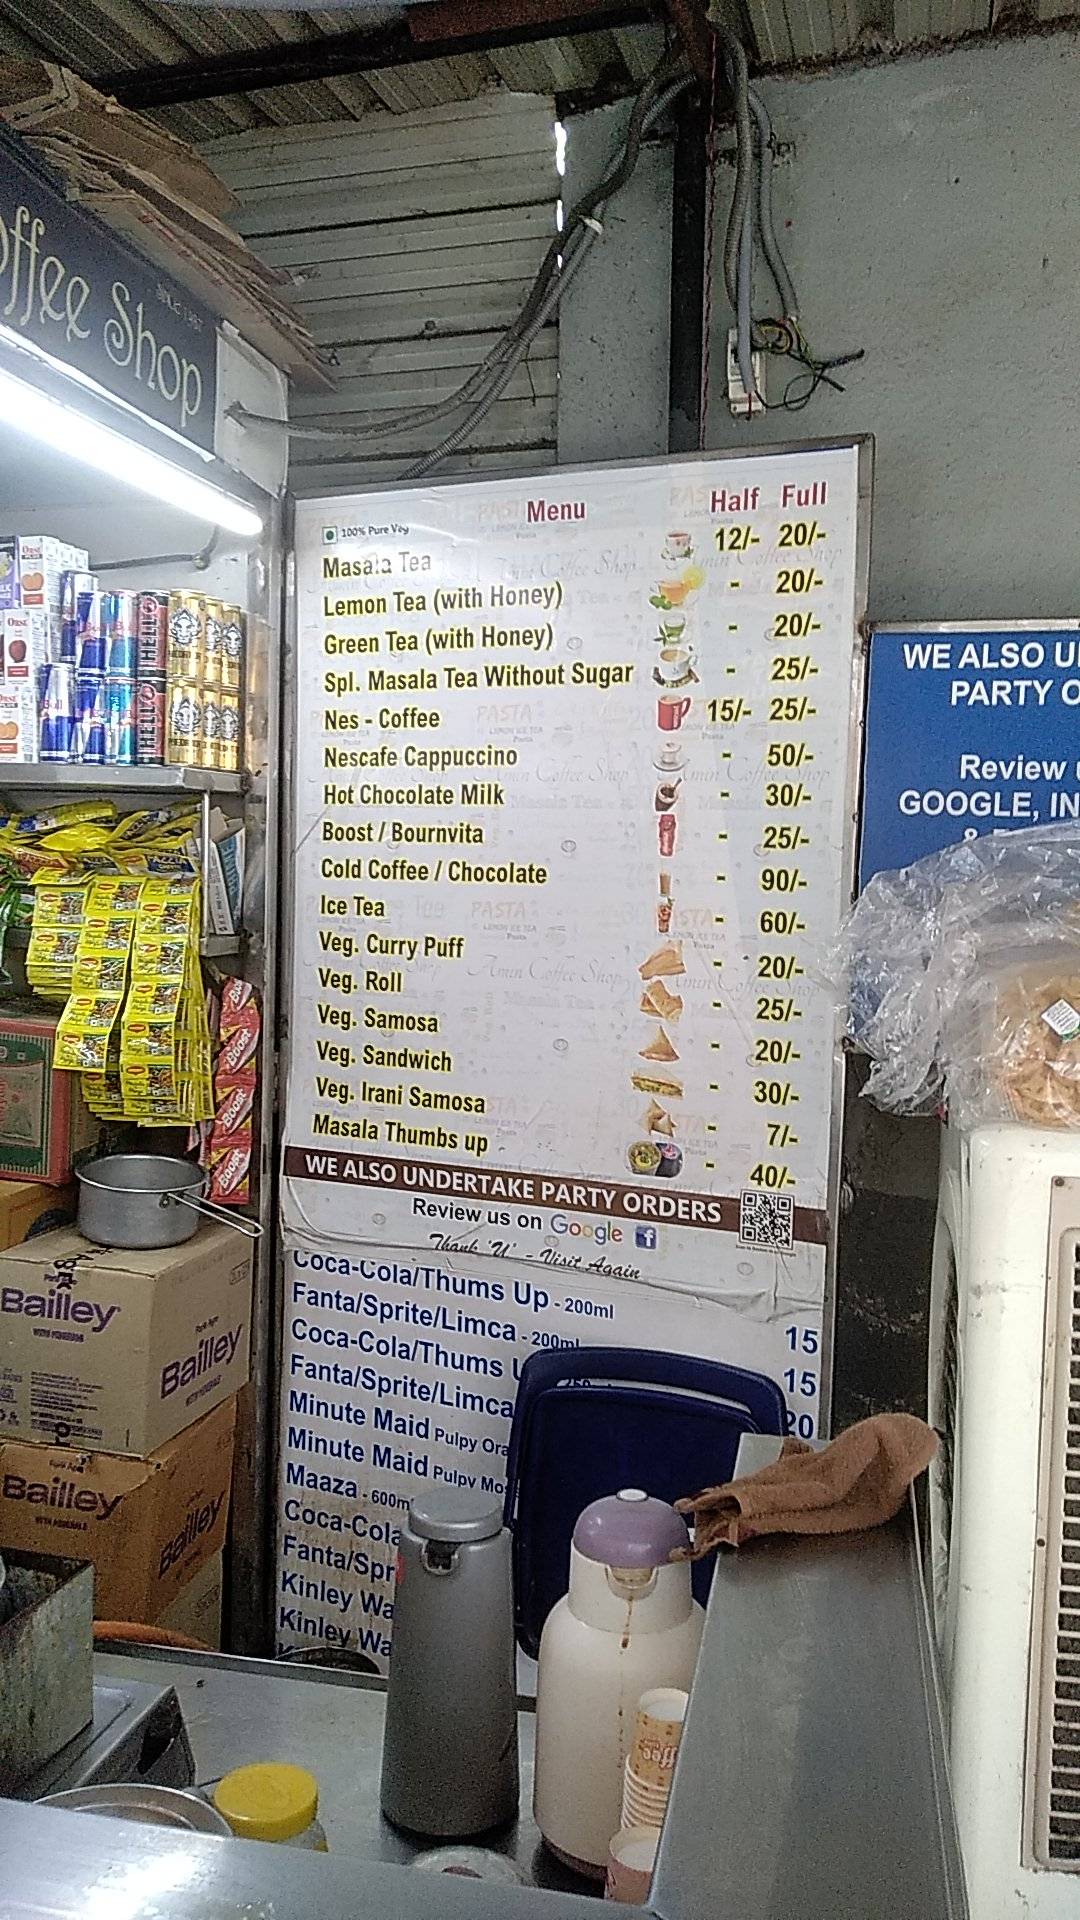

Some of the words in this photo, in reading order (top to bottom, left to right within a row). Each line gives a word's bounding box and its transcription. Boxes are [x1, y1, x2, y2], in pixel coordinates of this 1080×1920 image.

[104, 282, 201, 427] Shop
[527, 501, 586, 522] Menu
[711, 488, 760, 512] Half
[782, 482, 826, 508] Full
[341, 527, 366, 538] 100%
[368, 526, 389, 535] Pure
[715, 526, 760, 551] 12/-
[778, 522, 826, 547] 20/-
[399, 551, 432, 572] Tea
[776, 568, 823, 594] 20/-
[324, 596, 387, 617] Lemon
[393, 592, 426, 612] Tea
[433, 588, 483, 615] (with
[490, 581, 563, 610] Honey)
[324, 634, 379, 654] Green
[385, 631, 418, 651] Tea
[425, 628, 474, 655] (with
[481, 623, 553, 651] Honey)
[774, 612, 821, 637] 20/-
[772, 656, 819, 681] 25/-
[903, 643, 951, 669] WE
[958, 641, 1045, 668] ALSO
[324, 671, 360, 697] Spl.
[368, 670, 437, 691] Masala
[443, 667, 478, 688] Tea
[484, 663, 566, 687] Without
[571, 662, 634, 688] Sugar
[951, 679, 1054, 706] PARTY
[324, 710, 359, 730] Nes
[379, 707, 440, 728] Coffee
[707, 698, 752, 722] 15/-
[770, 697, 817, 721] 25/-
[324, 747, 398, 768] Nescafe
[404, 745, 518, 771] Cappuccino
[767, 743, 814, 767] 50/-
[960, 754, 1067, 781] Review
[324, 784, 355, 804] Hot
[360, 784, 453, 805] Chocolate
[461, 783, 505, 805] Milk
[765, 783, 812, 807] 30/-
[900, 790, 1040, 822] GOOGLE,
[1051, 792, 1080, 817] IN
[322, 822, 373, 842] Boost
[391, 822, 483, 843] Bournvita
[763, 826, 810, 850] 25/-
[321, 858, 361, 879] Cold
[368, 859, 429, 881] Coffee
[449, 861, 548, 884] Chocolate
[761, 869, 807, 892] 90/-
[320, 895, 347, 915] Ice
[353, 896, 385, 917] Tea
[760, 911, 805, 935] 60/-
[320, 932, 359, 957] Veg.
[366, 934, 418, 960] Curry
[424, 937, 465, 958] Puff
[318, 968, 358, 994] Veg.
[365, 971, 403, 992] Roll
[758, 955, 804, 979] 20/-
[317, 1004, 357, 1030] Veg.
[364, 1008, 439, 1032] Samosa
[756, 998, 802, 1022] 25/-
[227, 1028, 251, 1067] Boost
[317, 1041, 356, 1067] Veg.
[363, 1045, 452, 1072] Sandwich
[755, 1040, 801, 1064] 20/-
[316, 1077, 355, 1104] Veg.
[362, 1082, 402, 1106] Irani
[409, 1086, 486, 1113] Samosa
[754, 1081, 800, 1105] 30/-
[222, 1088, 246, 1128] Boost
[313, 1114, 378, 1140] Masala
[386, 1120, 457, 1149] Thumbs
[465, 1134, 488, 1157] up
[767, 1123, 798, 1147] 7/-
[219, 1149, 245, 1190] Boost
[750, 1164, 796, 1189] 40/-
[305, 1155, 338, 1176] WE
[343, 1160, 396, 1182] ALSO
[403, 1166, 534, 1199] UNDERTAKE
[541, 1182, 616, 1210] PARTY
[623, 1193, 722, 1223] ORDERS
[413, 1198, 481, 1222] Review
[487, 1211, 511, 1226] us
[517, 1214, 542, 1230] on
[550, 1214, 623, 1245] Google
[429, 1233, 478, 1252] Thank
[540, 1249, 583, 1270] Visit
[585, 1257, 641, 1280] Again
[293, 1251, 505, 1302] Coca-Cola/Thums
[513, 1281, 549, 1313] Up
[564, 1298, 614, 1319] 200ml
[1, 1287, 119, 1332] Bailley
[293, 1282, 516, 1342] Fanta/Sprite/Limca
[292, 1318, 503, 1378] Coca-Cola/Thums
[785, 1326, 818, 1354] 15
[161, 1323, 242, 1399] Bailley
[290, 1354, 514, 1418] Fanta/Sprite/Limca
[784, 1368, 817, 1397] 15
[289, 1390, 366, 1427] Minute
[374, 1404, 430, 1440] Maid
[435, 1428, 477, 1453] Pulpy
[288, 1427, 364, 1464] Minute
[373, 1443, 428, 1478] Maid
[3, 1474, 124, 1521] Bailley
[287, 1463, 358, 1501] Maaza
[371, 1488, 414, 1511] 600m
[158, 1490, 226, 1580] Bailley
[285, 1500, 400, 1545] Coca-Cola
[283, 1535, 395, 1583] Fanta/Spr
[281, 1570, 353, 1613] Kinley
[361, 1590, 394, 1620] Wa
[280, 1607, 351, 1648] Kinley
[359, 1627, 392, 1657] Wa
